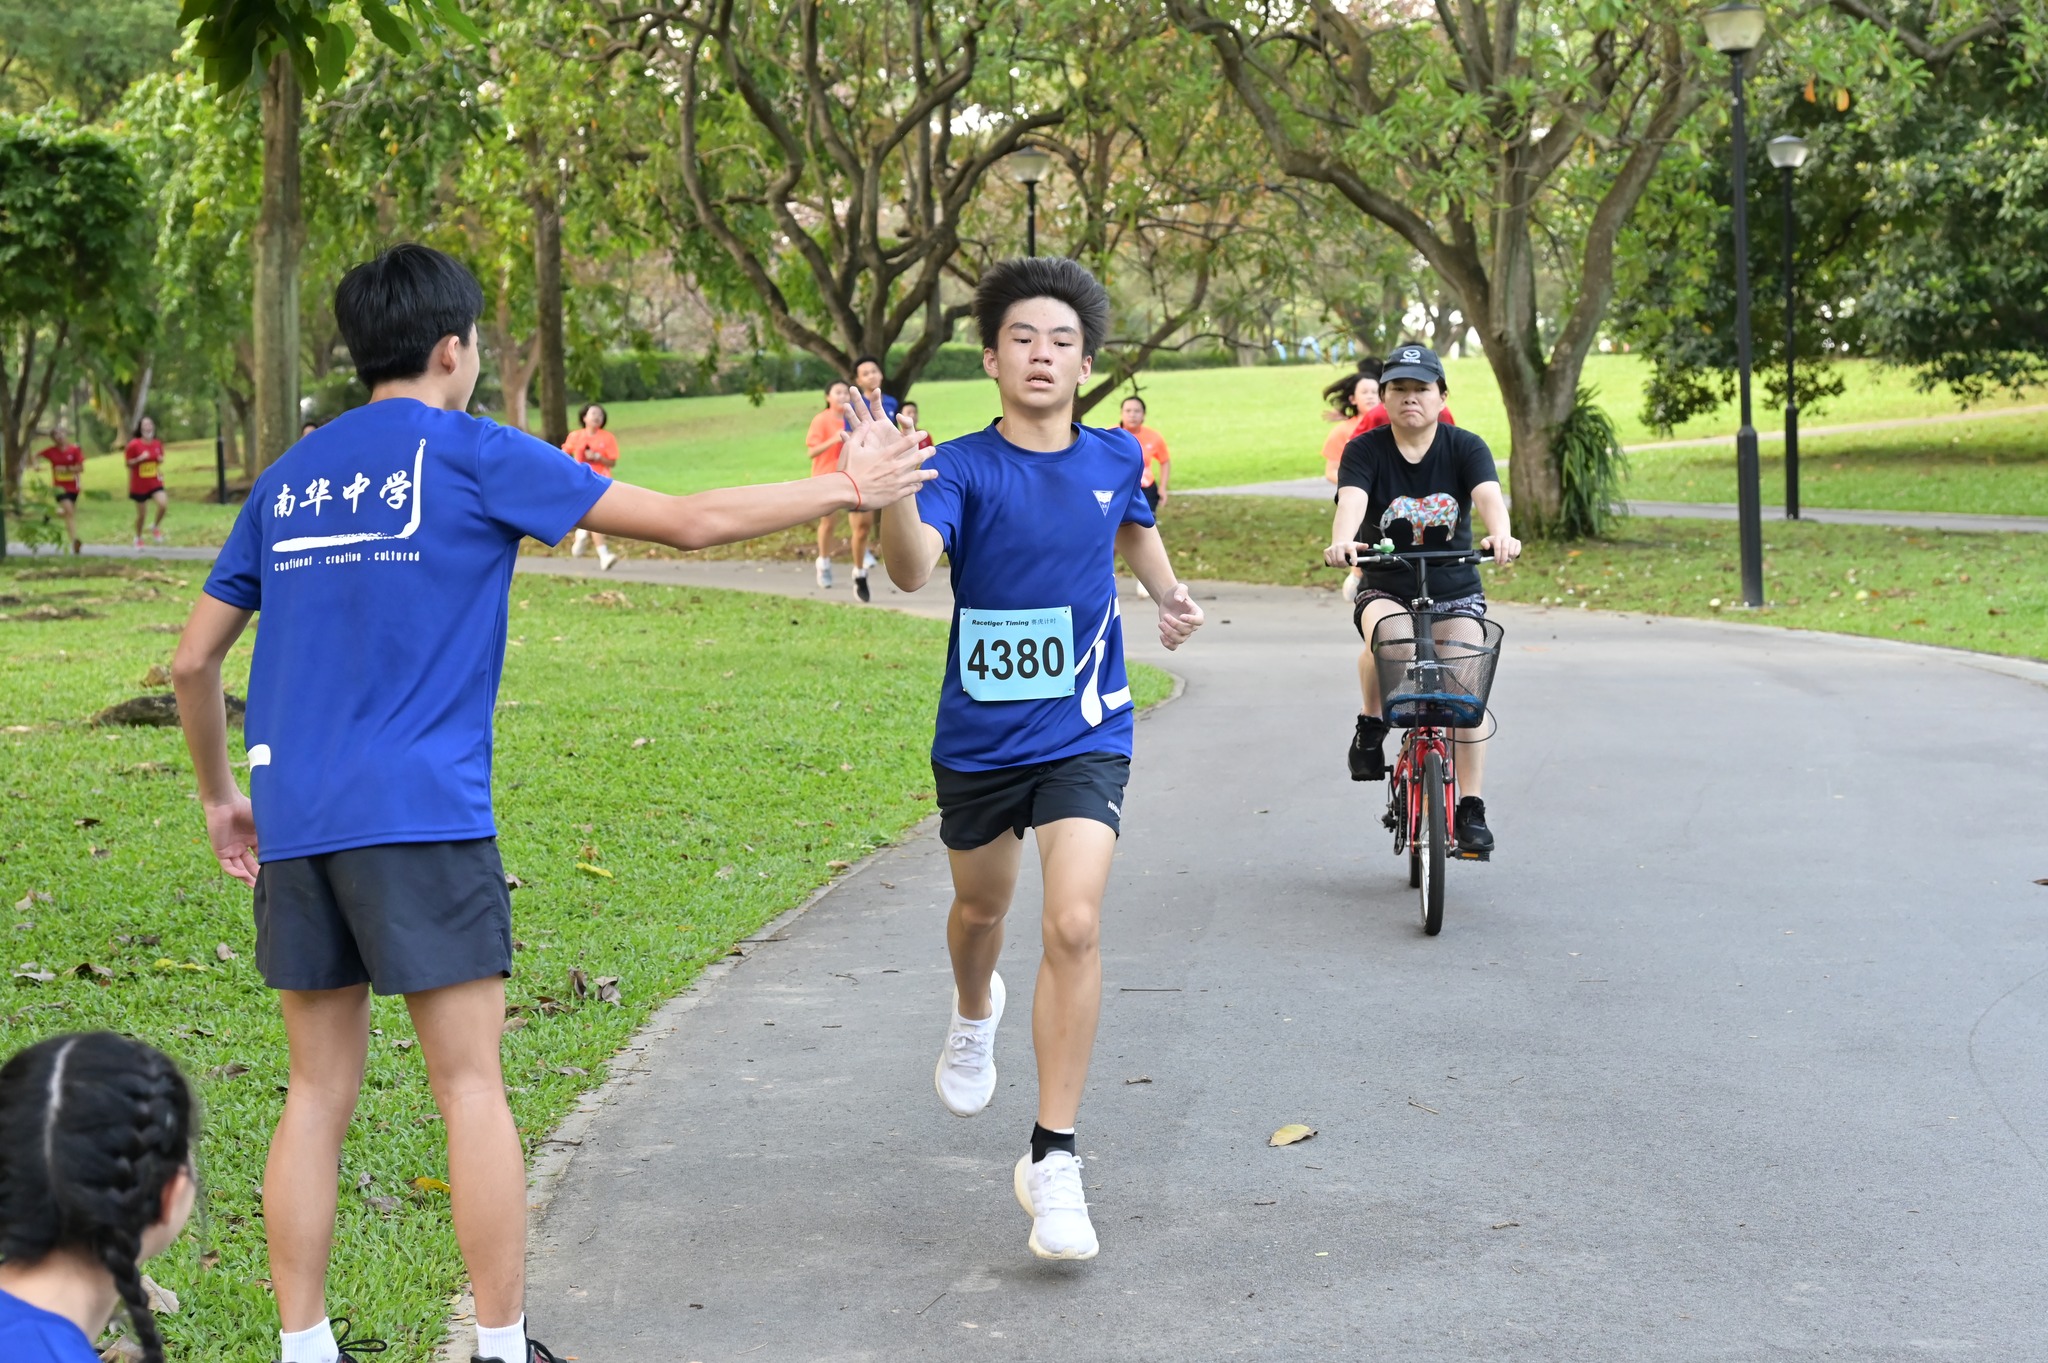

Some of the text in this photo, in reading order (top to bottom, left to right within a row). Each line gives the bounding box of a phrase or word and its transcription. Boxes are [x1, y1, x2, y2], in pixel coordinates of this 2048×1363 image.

[273, 470, 412, 518] 南华中学
[274, 555, 313, 572] confident
[325, 551, 362, 565] creative
[374, 550, 420, 562] cultured
[971, 619, 1003, 628] Racetiger
[1005, 619, 1030, 627] Timing
[967, 636, 1065, 680] 4380
